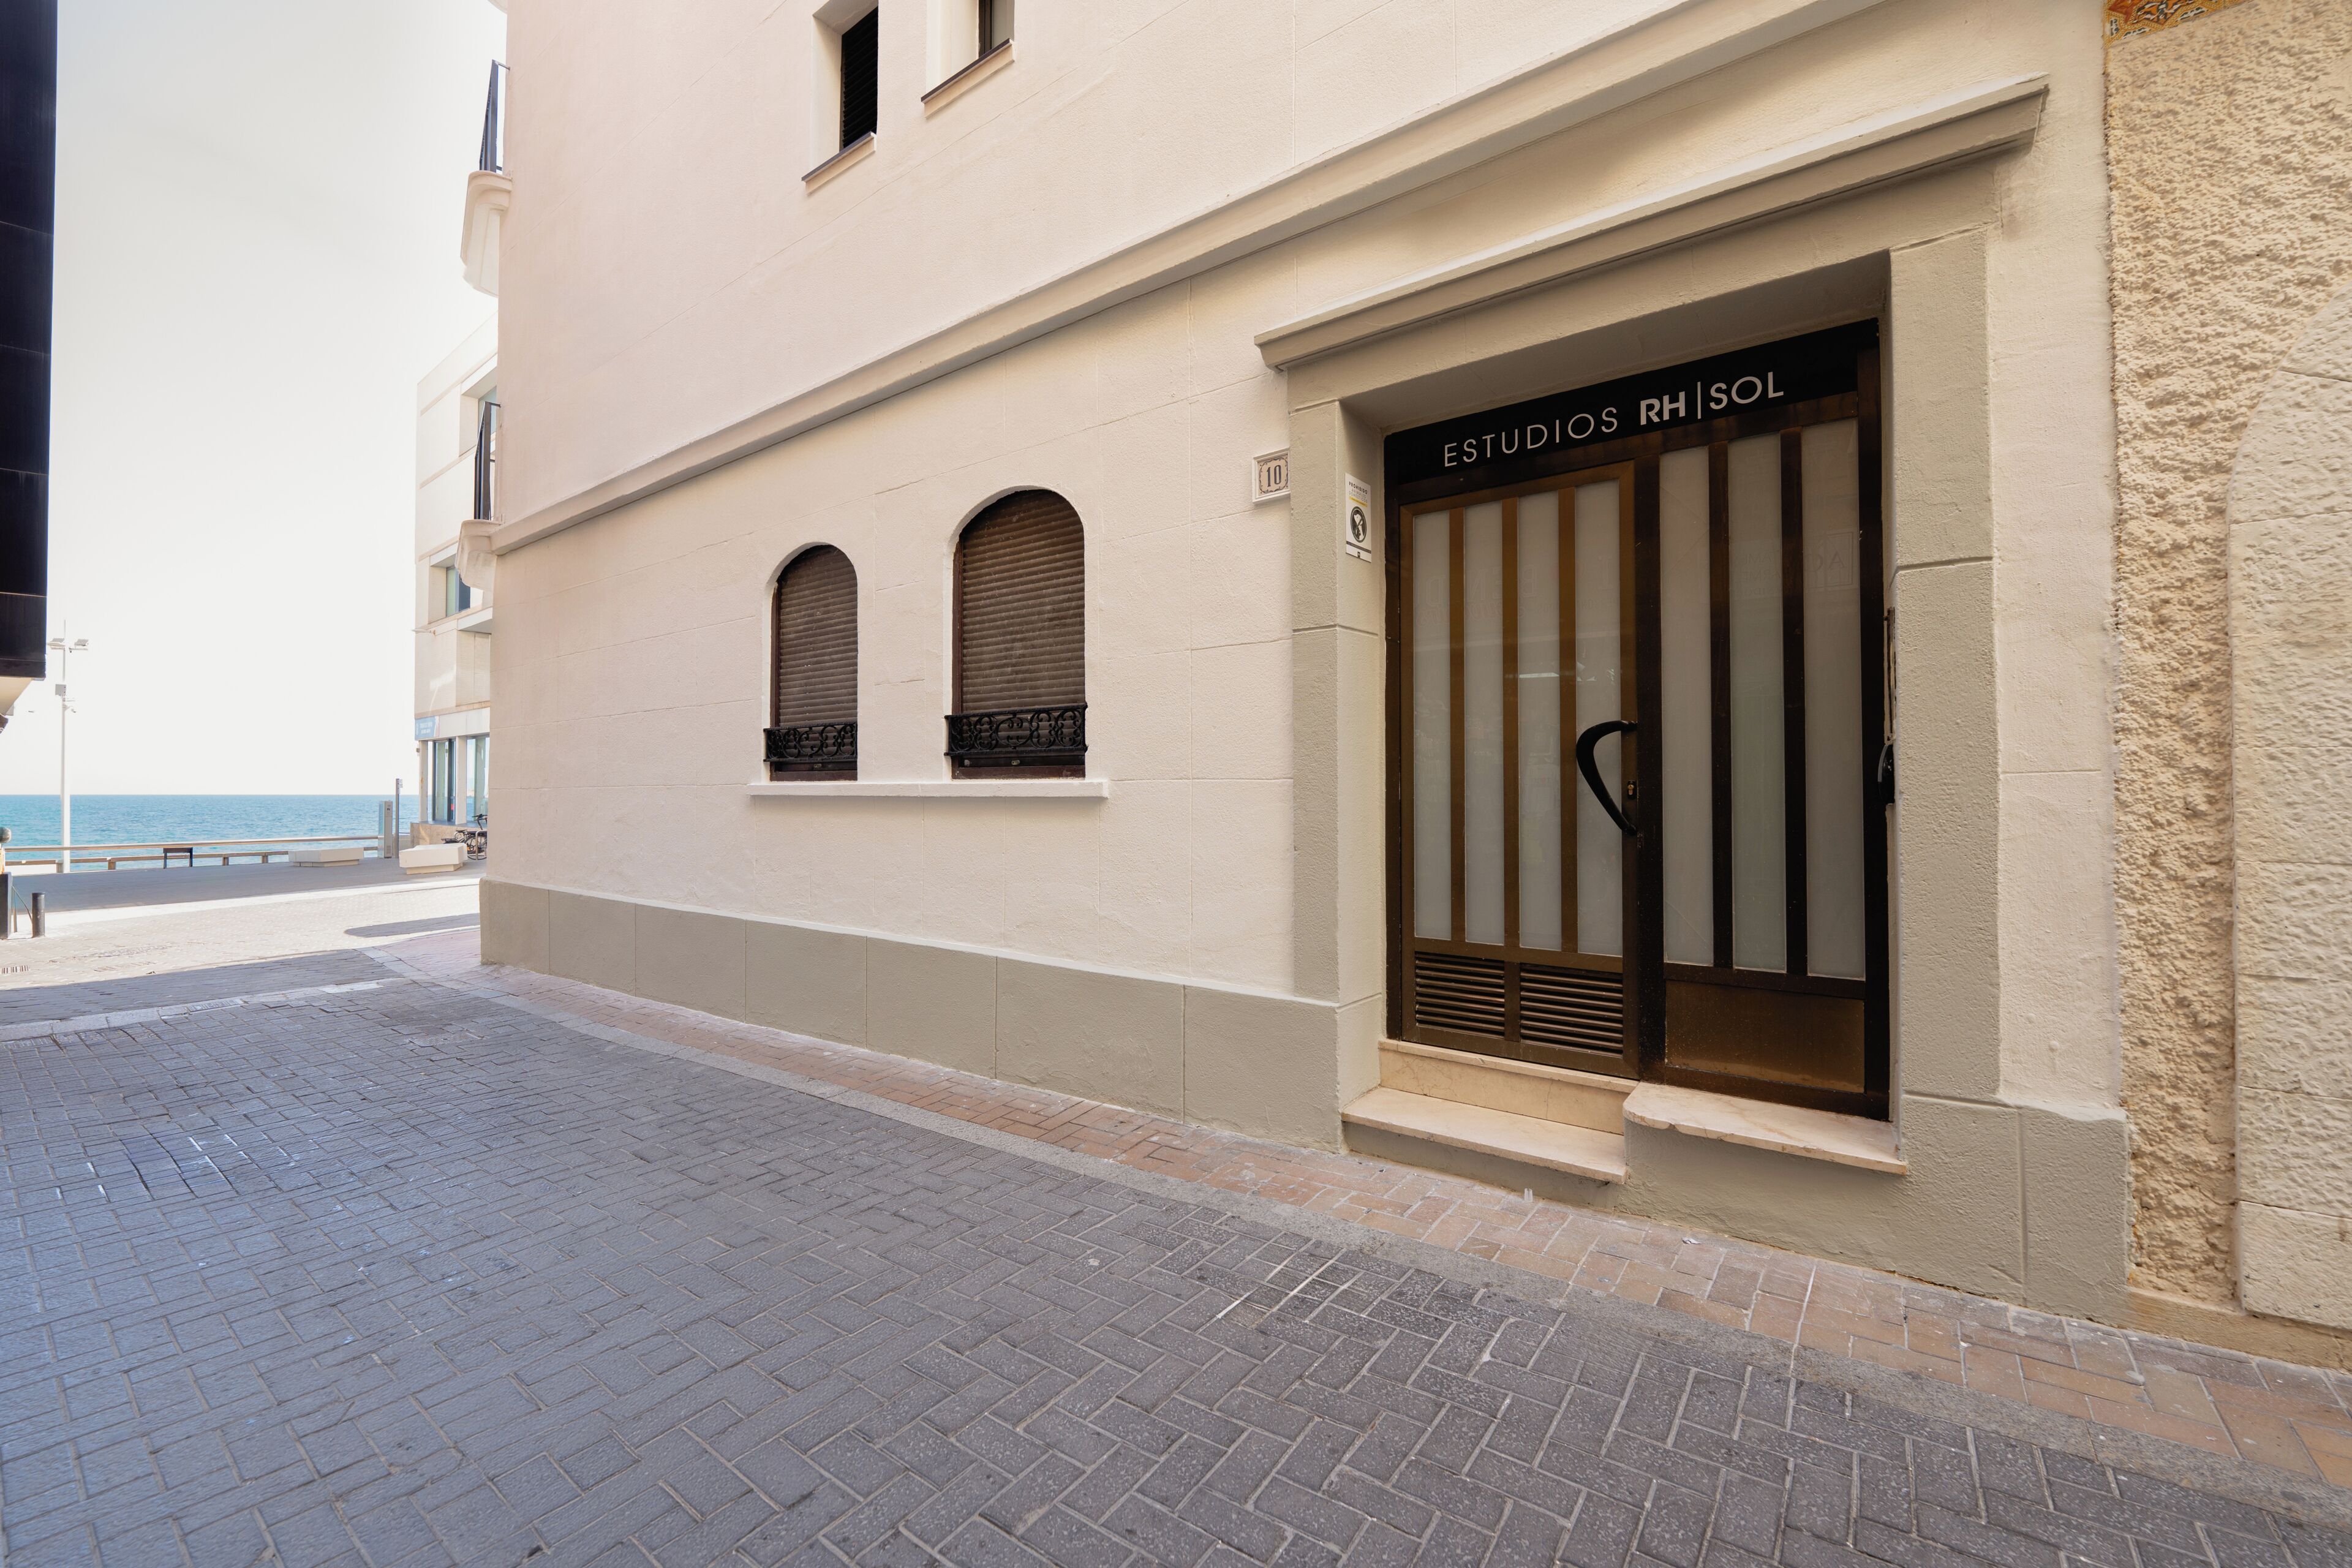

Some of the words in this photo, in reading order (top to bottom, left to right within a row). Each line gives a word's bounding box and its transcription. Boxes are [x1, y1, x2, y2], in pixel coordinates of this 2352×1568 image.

[1444, 407, 1618, 467] ESTUDIOS
[1266, 464, 1282, 488] 10
[1349, 481, 1368, 495] PROHIBIDO
